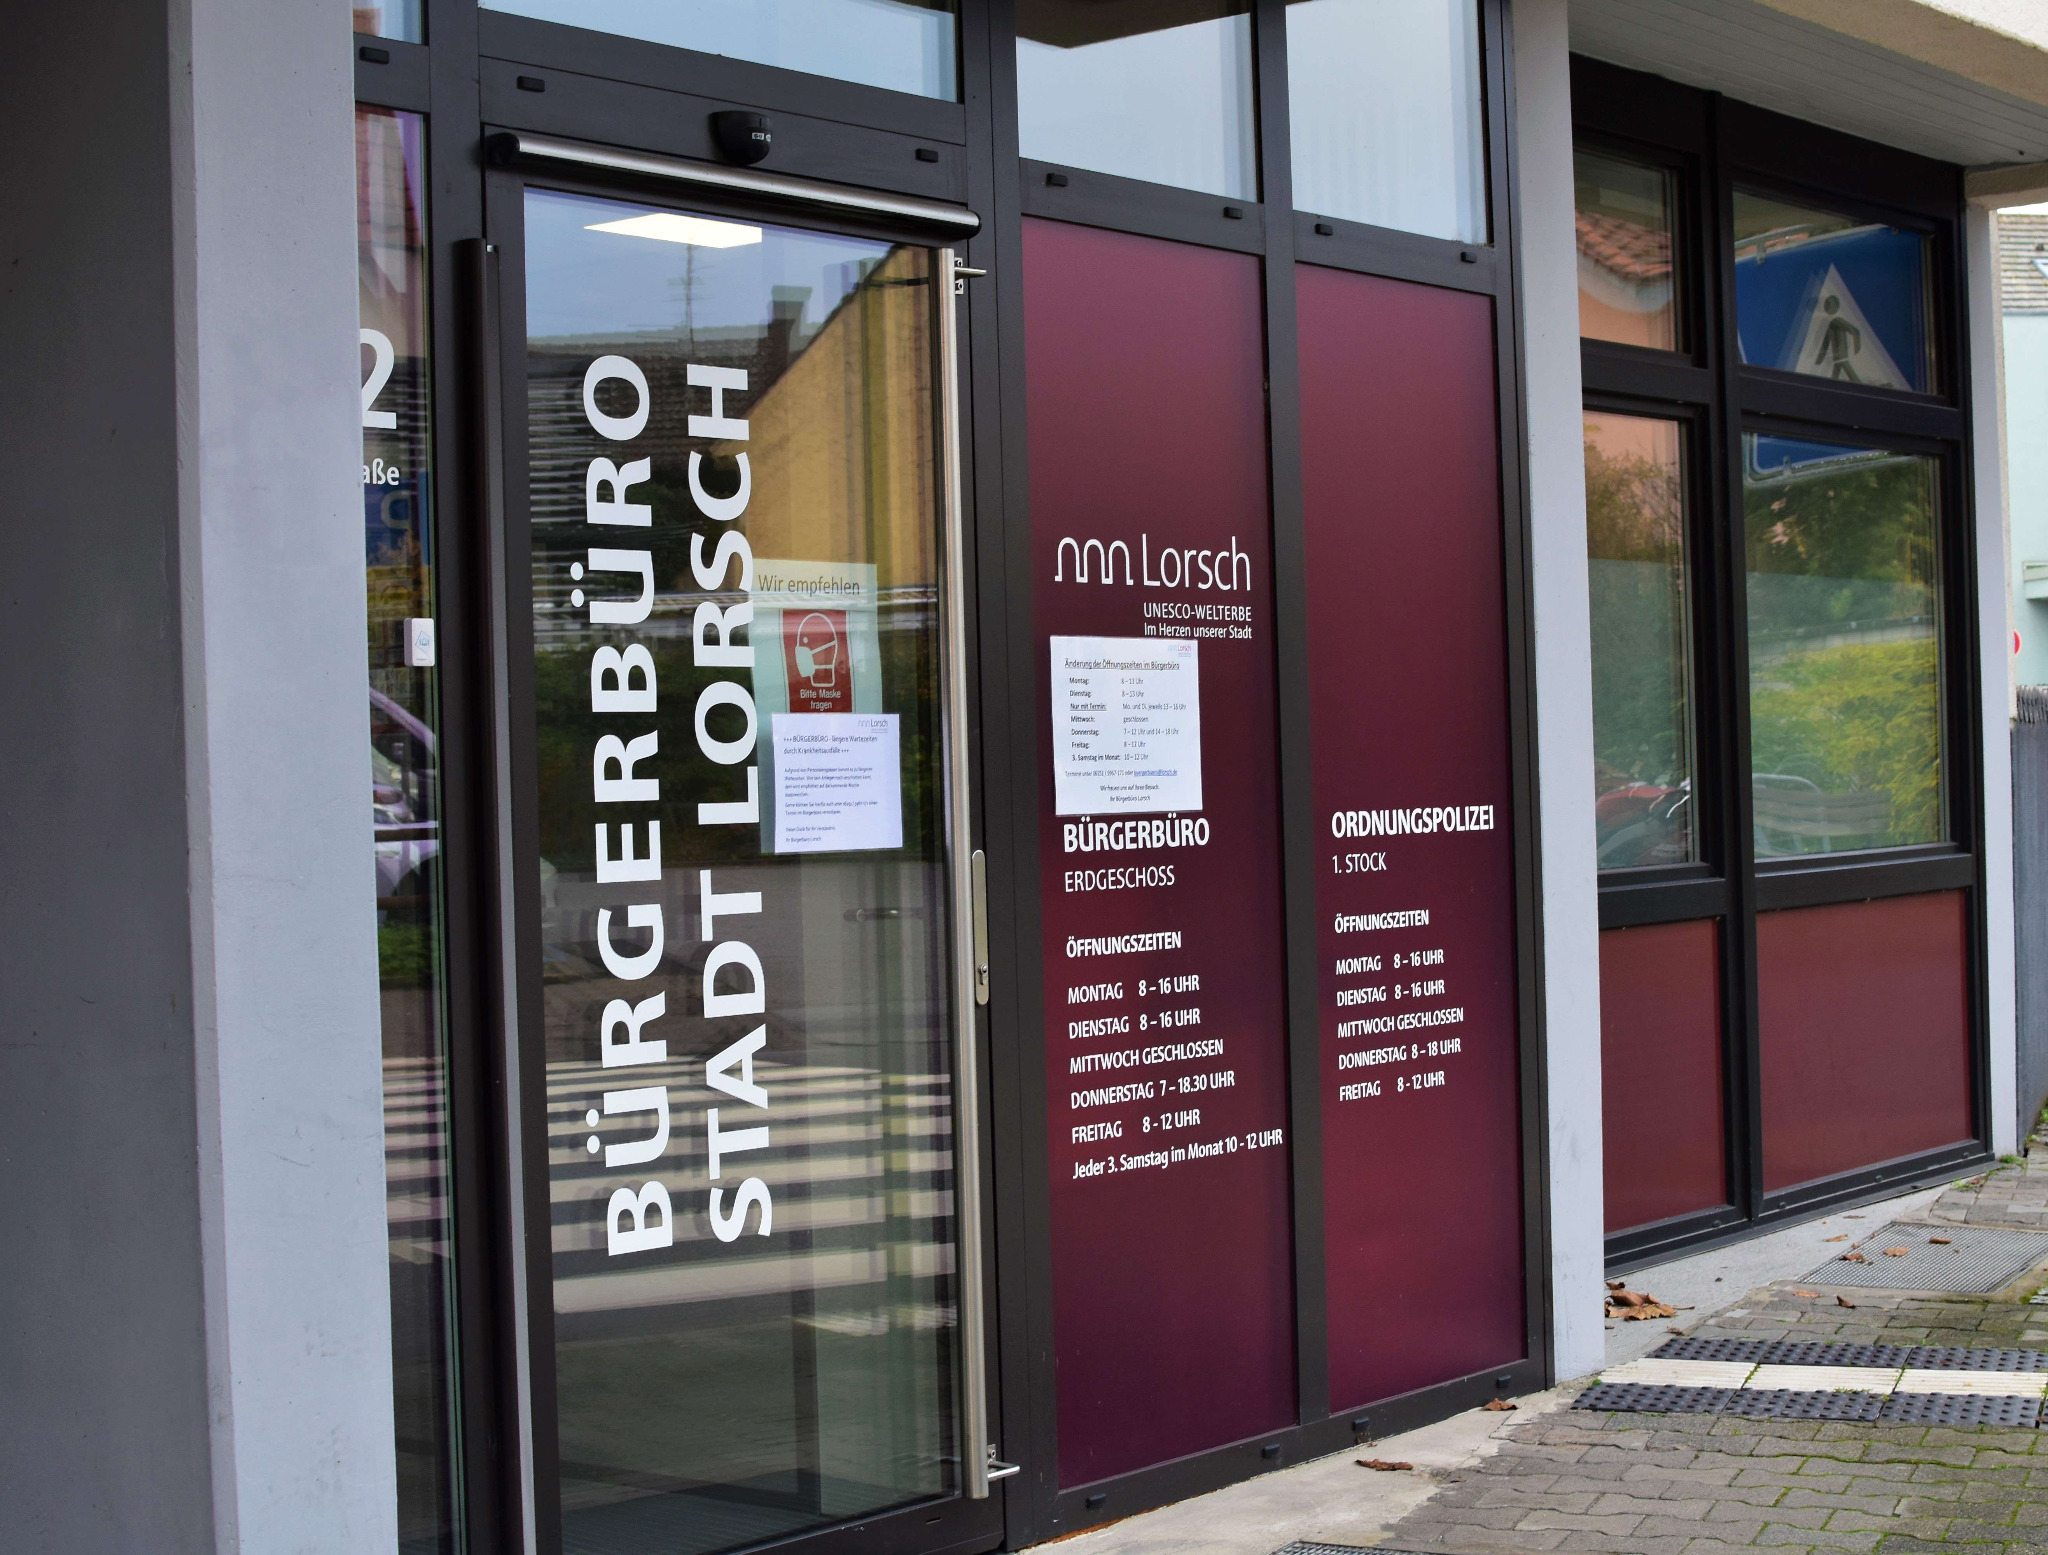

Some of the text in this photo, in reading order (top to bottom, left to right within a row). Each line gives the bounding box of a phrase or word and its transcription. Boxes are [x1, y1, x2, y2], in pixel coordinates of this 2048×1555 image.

[360, 328, 396, 429] 2
[1142, 534, 1250, 591] Lorsch
[758, 575, 860, 596] Wir empfehlen
[1144, 602, 1251, 621] UNESCO-WELTERBE
[1145, 623, 1252, 639] Im Herzen unserer Stadt
[1065, 658, 1092, 669] Änderung
[1093, 660, 1101, 668] der
[1102, 659, 1142, 670] Öffnungszeiten
[1151, 661, 1179, 671] Bürgerbüro
[800, 689, 841, 698] Bitte Maske
[1069, 677, 1089, 685] Montag:
[1070, 690, 1092, 698] Dienstag:
[871, 719, 888, 727] Lorsch
[793, 734, 828, 742] BÜRGERBÜRO
[570, 355, 672, 1256] BÜRGERBÜRO
[687, 364, 772, 1243] STADT LORSCH
[1064, 812, 1209, 852] BÜRGERBÜRO
[1332, 805, 1493, 838] ORDNUNGSPOLIZEI
[1333, 852, 1387, 873] 1. STOCK
[1065, 865, 1174, 892] ERDGESCHOSS
[1335, 910, 1429, 933] ÖFFNUNGSZEITEN
[1066, 931, 1181, 958] ÖFFNUNGSZEITEN
[1336, 955, 1381, 975] MONTAG
[1394, 954, 1400, 968] 8
[1410, 951, 1420, 966] 16
[1423, 949, 1444, 965] UHR
[1068, 982, 1123, 1004] MONTAG
[1139, 980, 1146, 996] 8
[1158, 978, 1171, 994] 16
[1174, 975, 1199, 992] UHR
[1337, 986, 1386, 1006] DIENSTAG
[1395, 985, 1401, 999] 8
[1411, 982, 1421, 997] 16
[1424, 980, 1445, 996] UHR
[1069, 1016, 1129, 1039] DIENSTAG
[1140, 1014, 1147, 1030] 8
[1159, 1011, 1172, 1028] 16
[1175, 1008, 1200, 1026] UHR
[1338, 1007, 1463, 1038] MITTWOCH GESCHLOSSEN
[1070, 1039, 1223, 1074] MITTWOCH GESCHLOSSEN
[1339, 1046, 1406, 1069] DONNERSTAG
[1412, 1044, 1418, 1059] 8
[1427, 1041, 1438, 1056] 18
[1440, 1038, 1461, 1054] UHR
[1071, 1082, 1154, 1109] DONNERSTAG
[1160, 1080, 1166, 1096] 7
[1178, 1074, 1207, 1093] 18.30
[1210, 1071, 1235, 1089] UHR
[1340, 1081, 1380, 1101] FREITAG
[1398, 1077, 1404, 1092] 8
[1412, 1074, 1422, 1089] 12
[1424, 1071, 1445, 1087] UHR
[1072, 1121, 1122, 1144] FREITAG
[1143, 1116, 1150, 1132] 8
[1160, 1113, 1172, 1130] 12
[1175, 1109, 1200, 1127] UHR
[1073, 1159, 1105, 1179] Jeder
[1108, 1156, 1118, 1173] 3.
[1120, 1151, 1168, 1171] Samstag
[1171, 1146, 1185, 1162] im
[1188, 1140, 1223, 1159] Monat
[1225, 1136, 1237, 1153] 10
[1246, 1133, 1257, 1149] 12
[1259, 1129, 1282, 1147] UHR
